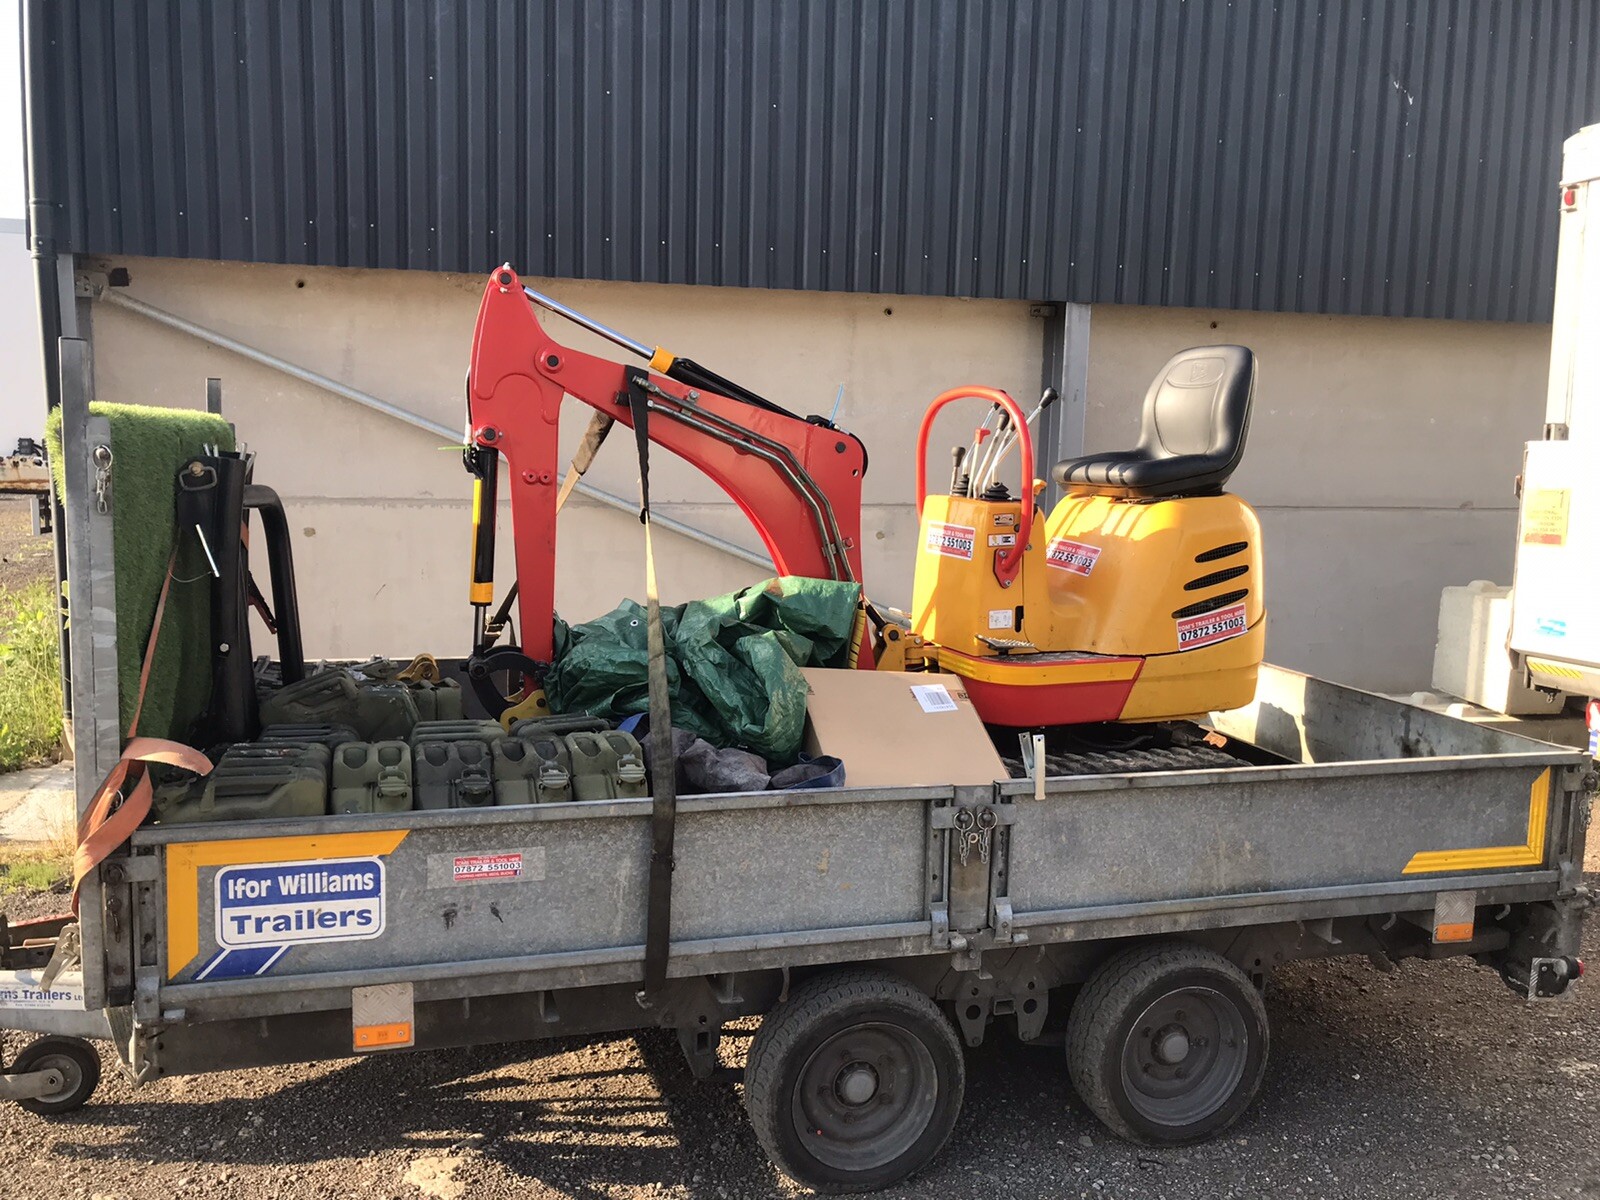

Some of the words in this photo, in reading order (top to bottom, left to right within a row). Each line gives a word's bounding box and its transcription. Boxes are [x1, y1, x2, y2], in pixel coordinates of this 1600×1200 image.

[947, 537, 972, 550] 551003
[1064, 552, 1093, 568] 551003
[1180, 626, 1210, 641] 07872
[1212, 616, 1244, 633] 551003
[1195, 617, 1216, 628] TRAILER
[454, 865, 484, 873] 07872
[488, 862, 521, 871] 551003
[228, 877, 271, 899] Ifor
[278, 871, 374, 896] Williams
[230, 909, 373, 935] Trailers
[22, 989, 72, 1000] Trailers
